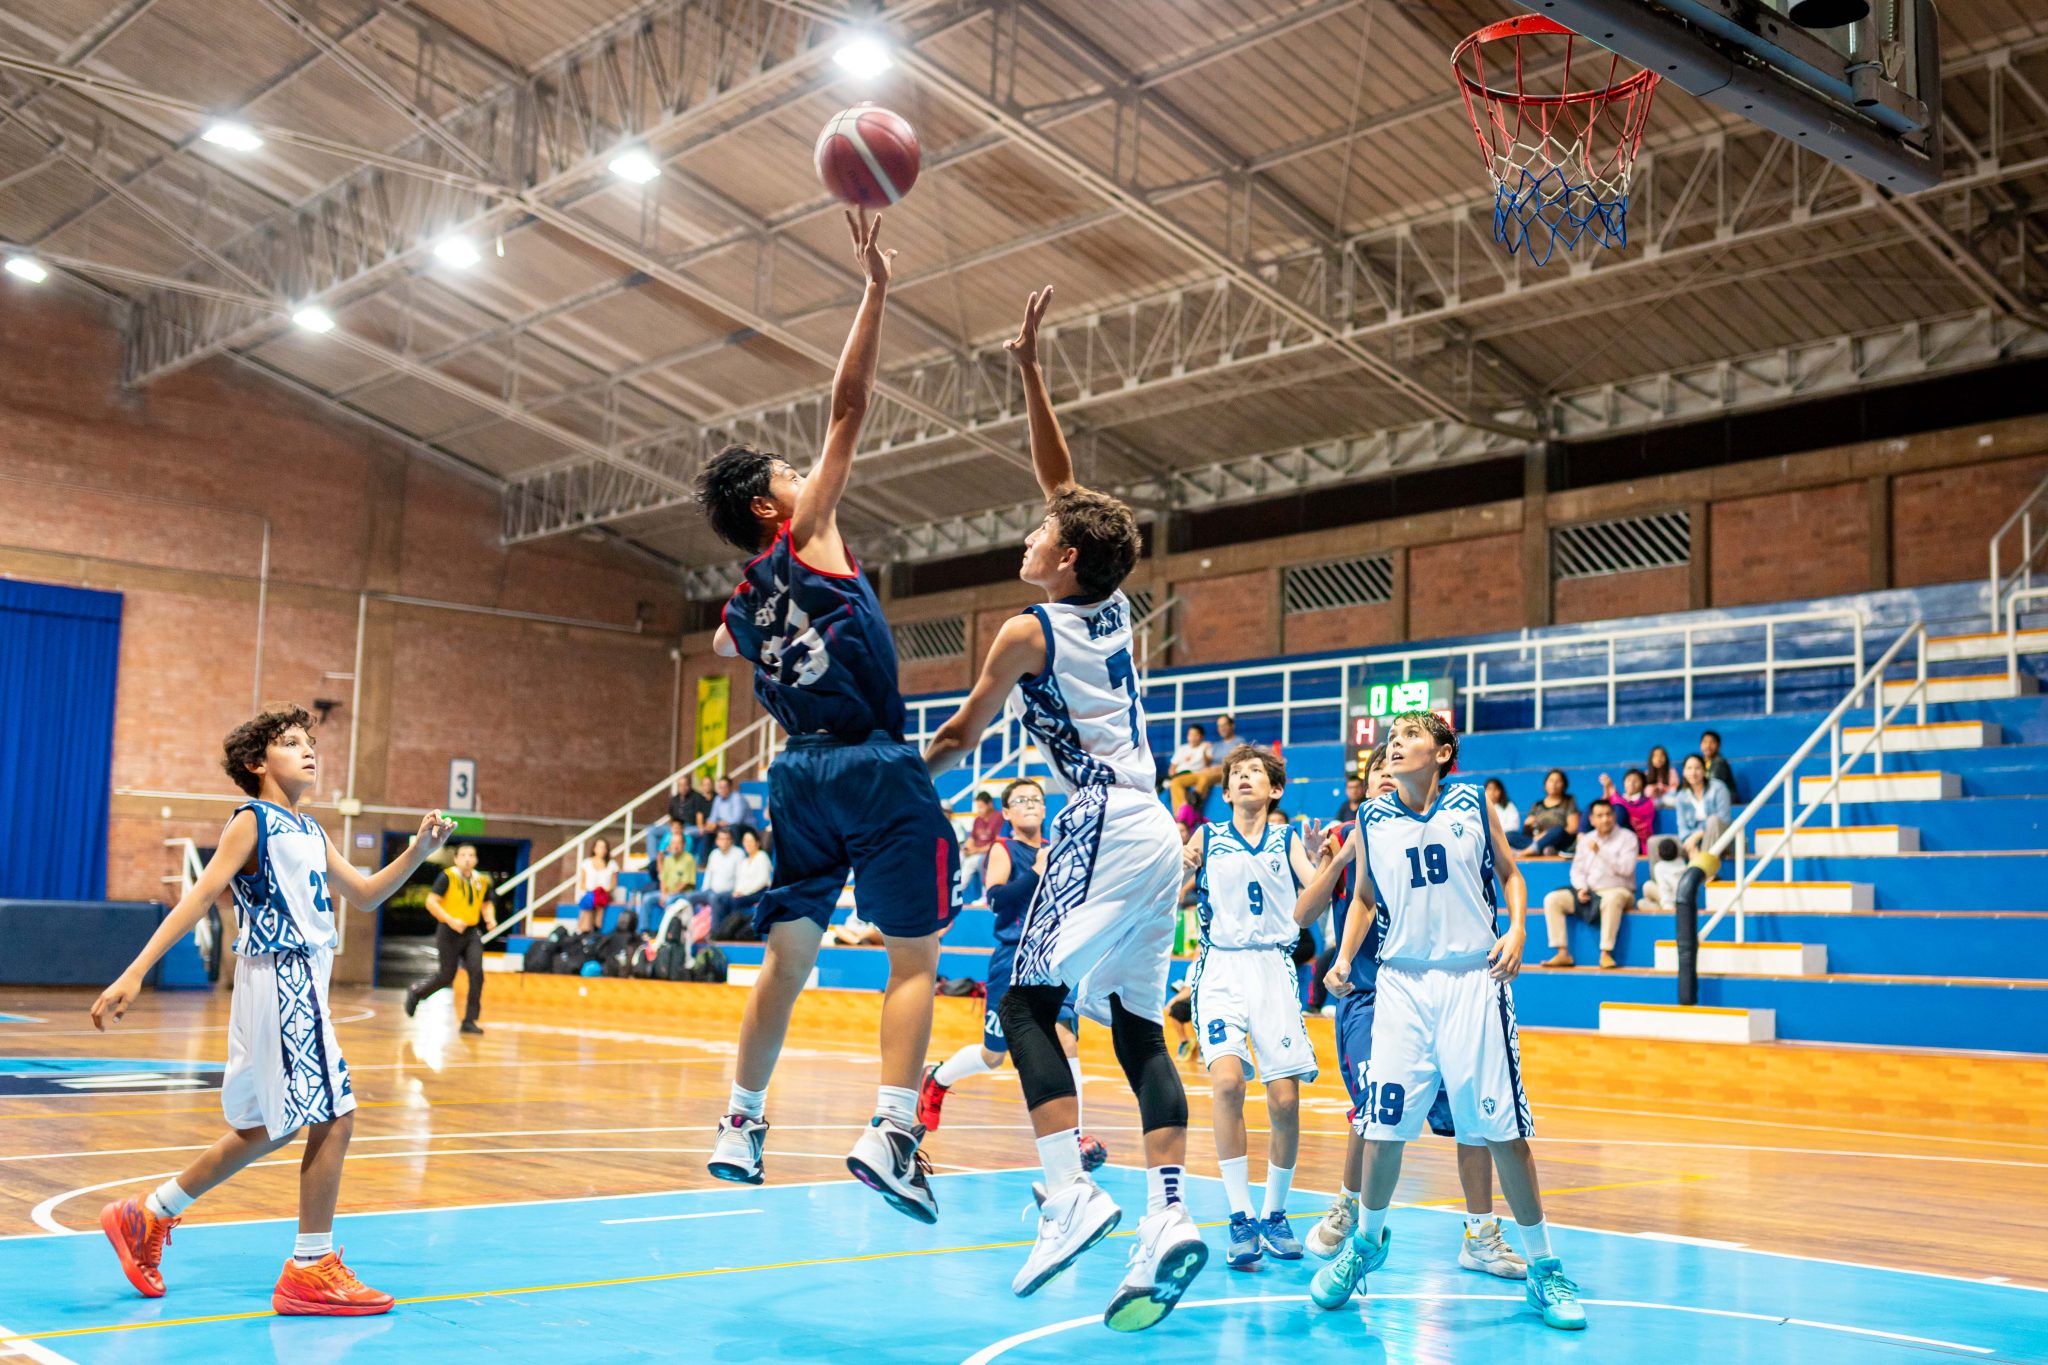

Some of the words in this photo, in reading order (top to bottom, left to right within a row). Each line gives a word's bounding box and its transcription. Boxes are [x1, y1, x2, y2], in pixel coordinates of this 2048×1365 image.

[1105, 647, 1140, 749] 7
[456, 773, 469, 798] 3
[1405, 843, 1449, 889] 19
[1247, 878, 1264, 916] 9
[1368, 1081, 1406, 1127] 19
